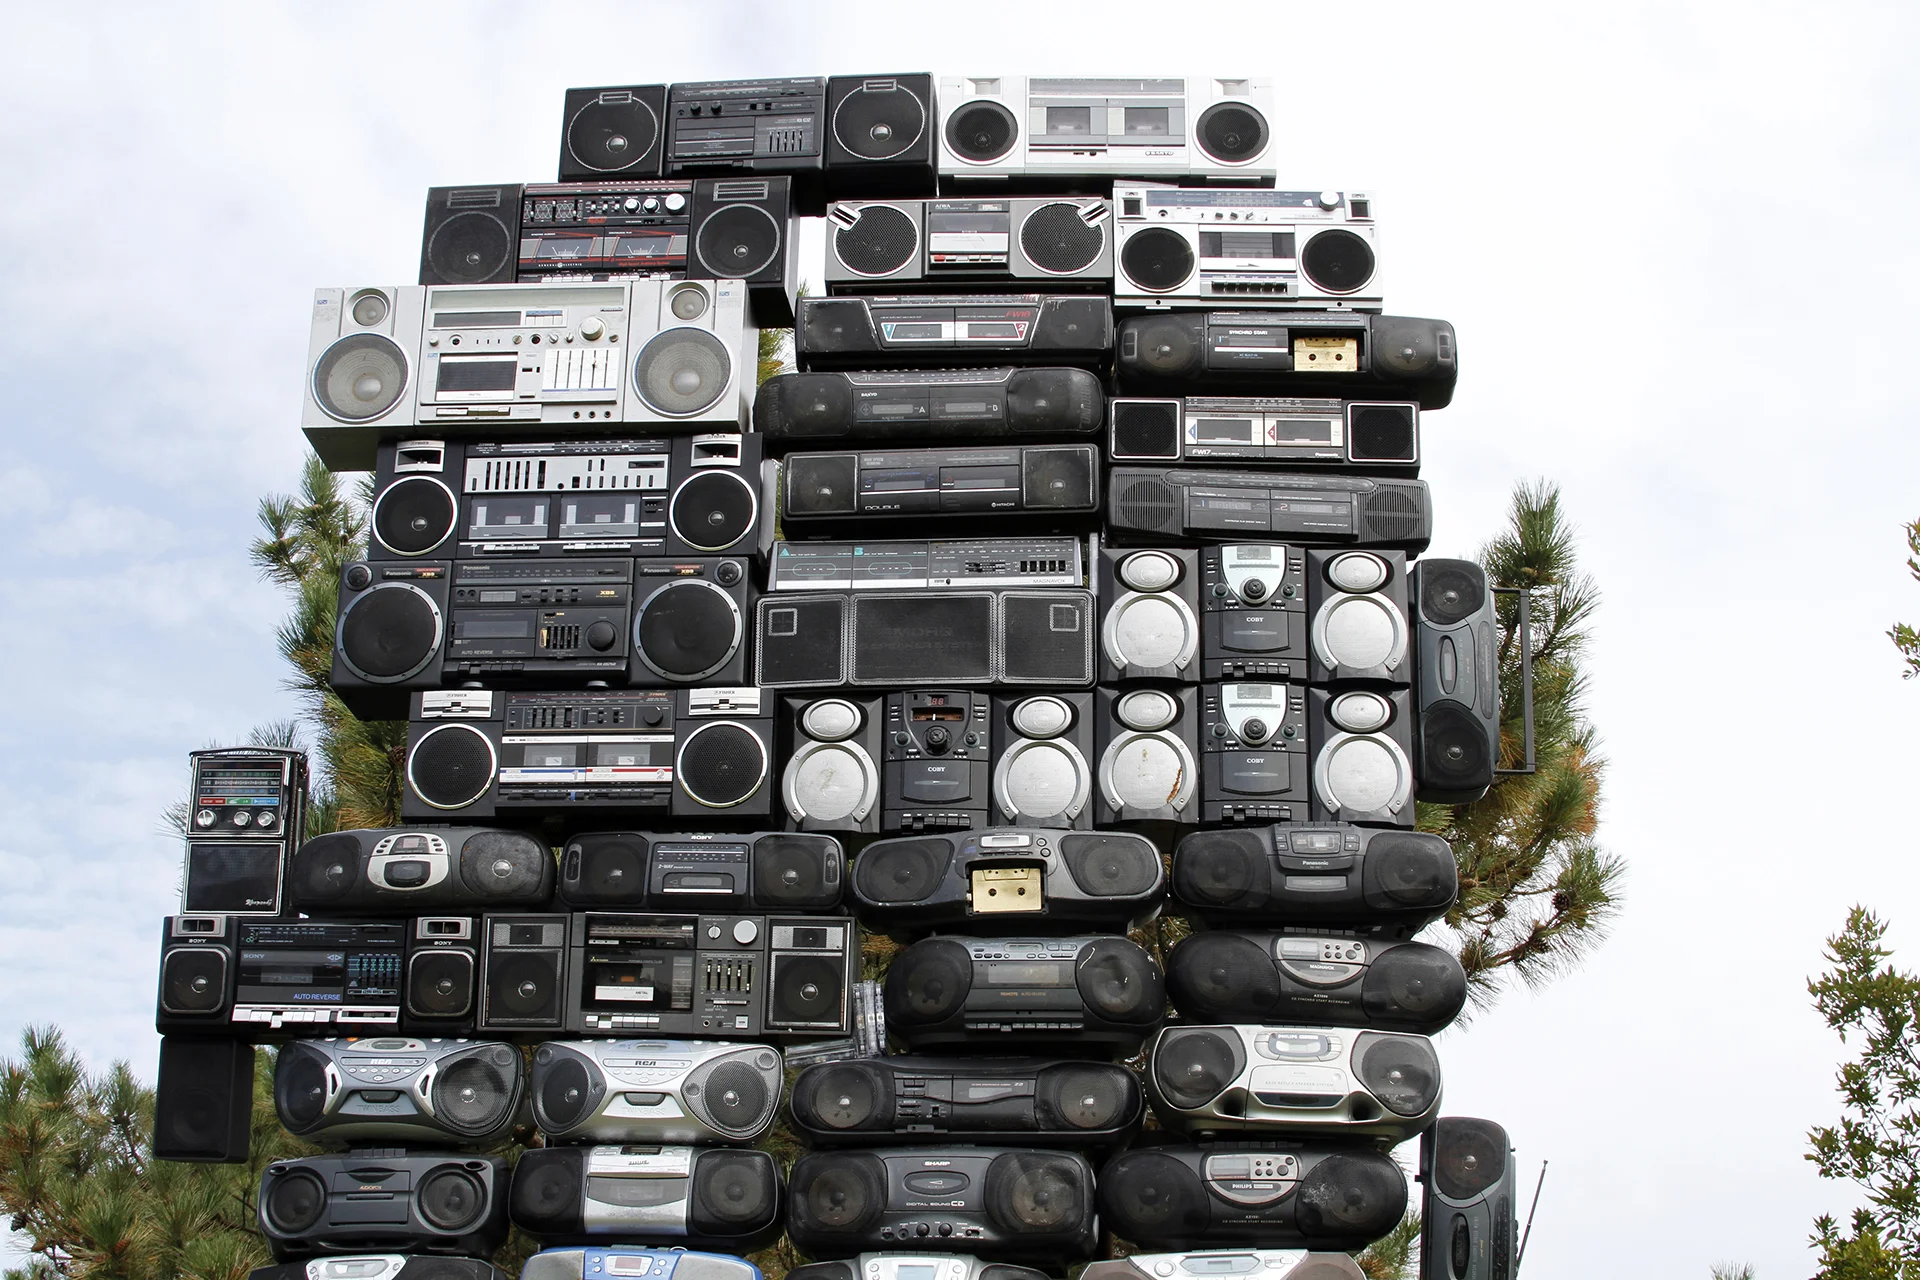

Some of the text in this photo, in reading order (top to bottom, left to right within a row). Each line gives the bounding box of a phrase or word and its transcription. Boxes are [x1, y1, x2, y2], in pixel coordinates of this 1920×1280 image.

[1018, 323, 1025, 331] 2
[1280, 502, 1288, 511] 2
[854, 547, 864, 556] B
[572, 769, 579, 780] 1
[656, 768, 665, 780] 2
[311, 993, 341, 1001] REVERSE
